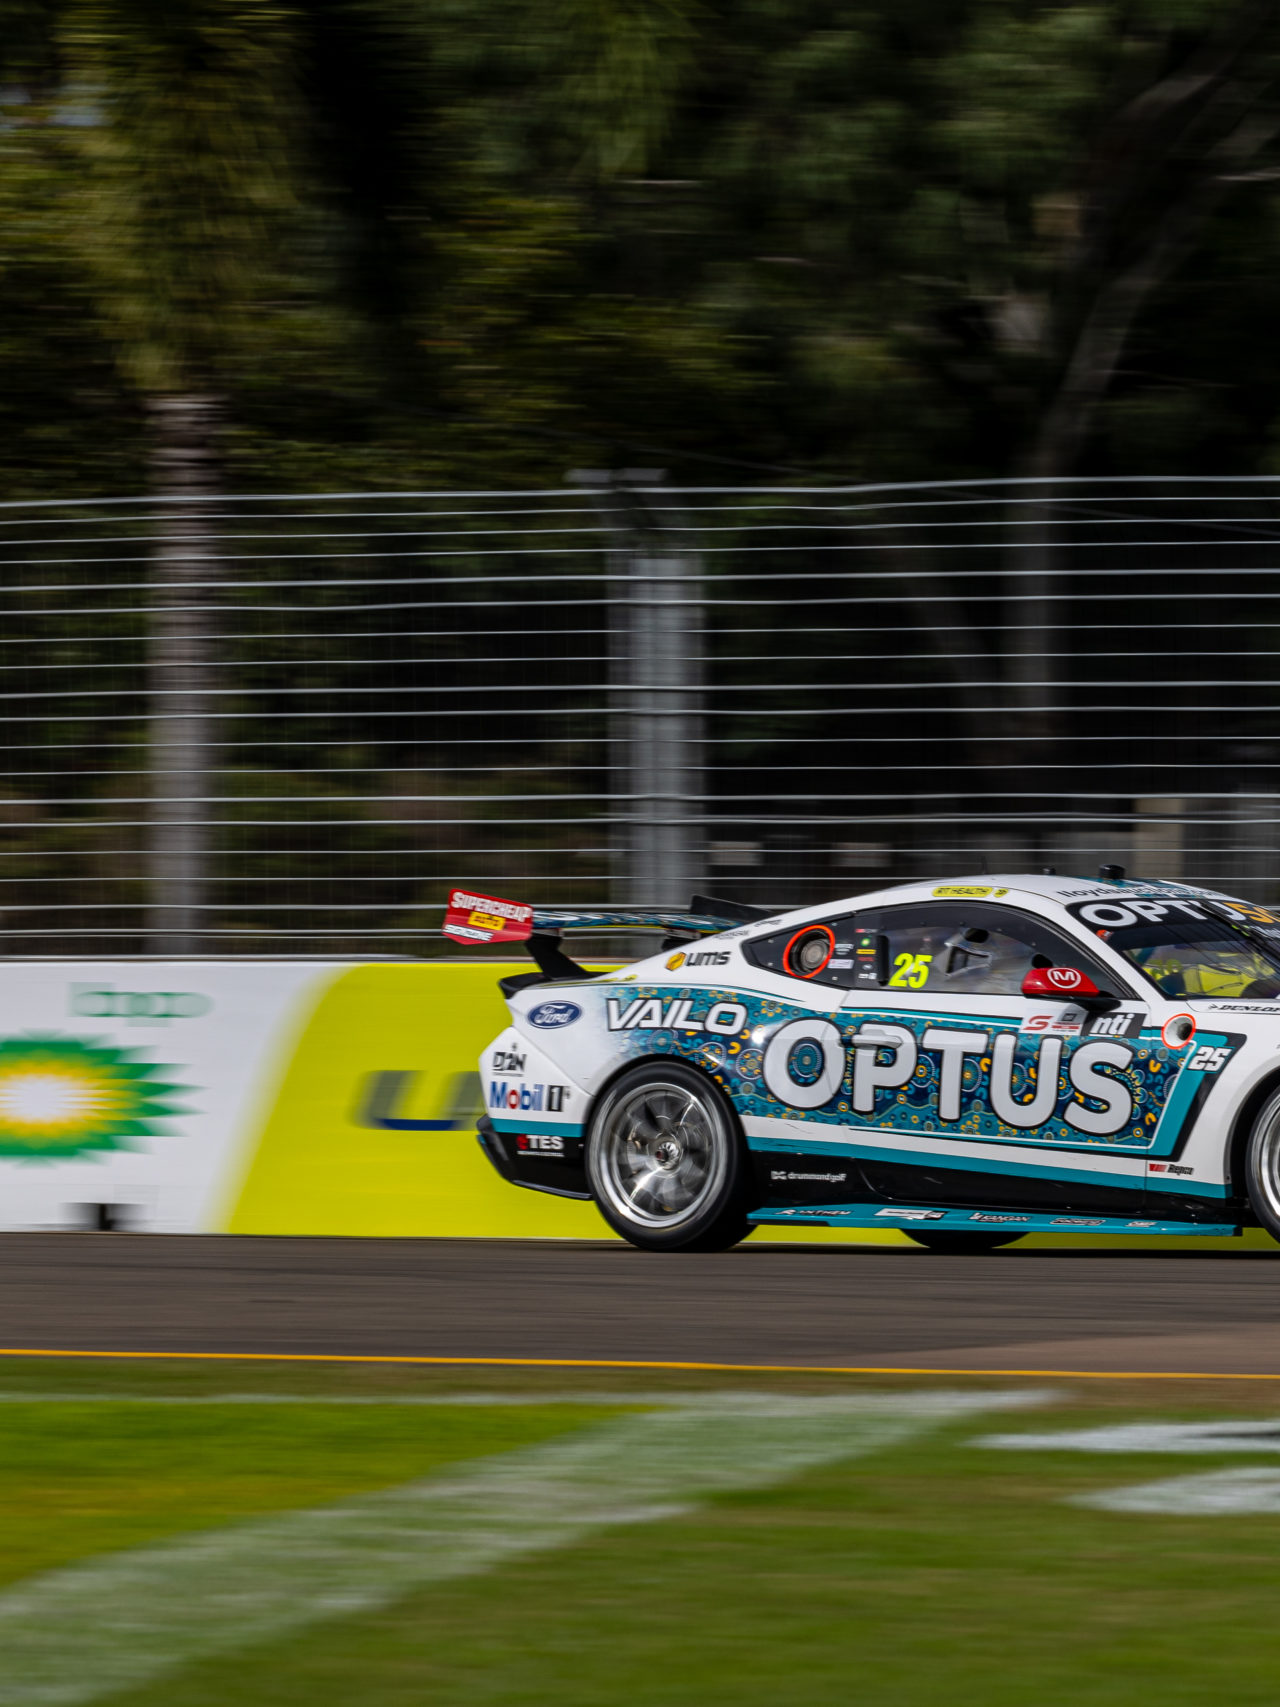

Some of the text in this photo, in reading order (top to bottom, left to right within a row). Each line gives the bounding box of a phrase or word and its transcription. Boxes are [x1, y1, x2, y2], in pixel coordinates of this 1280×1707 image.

[451, 891, 532, 922] SUPERCHEAP
[889, 953, 932, 988] 25
[606, 998, 748, 1036] VAILO
[1089, 1013, 1135, 1035] nti
[1188, 1047, 1229, 1071] 25
[763, 1016, 1134, 1135] OPTUS
[490, 1081, 544, 1112] Mobil
[547, 1085, 565, 1112] 1
